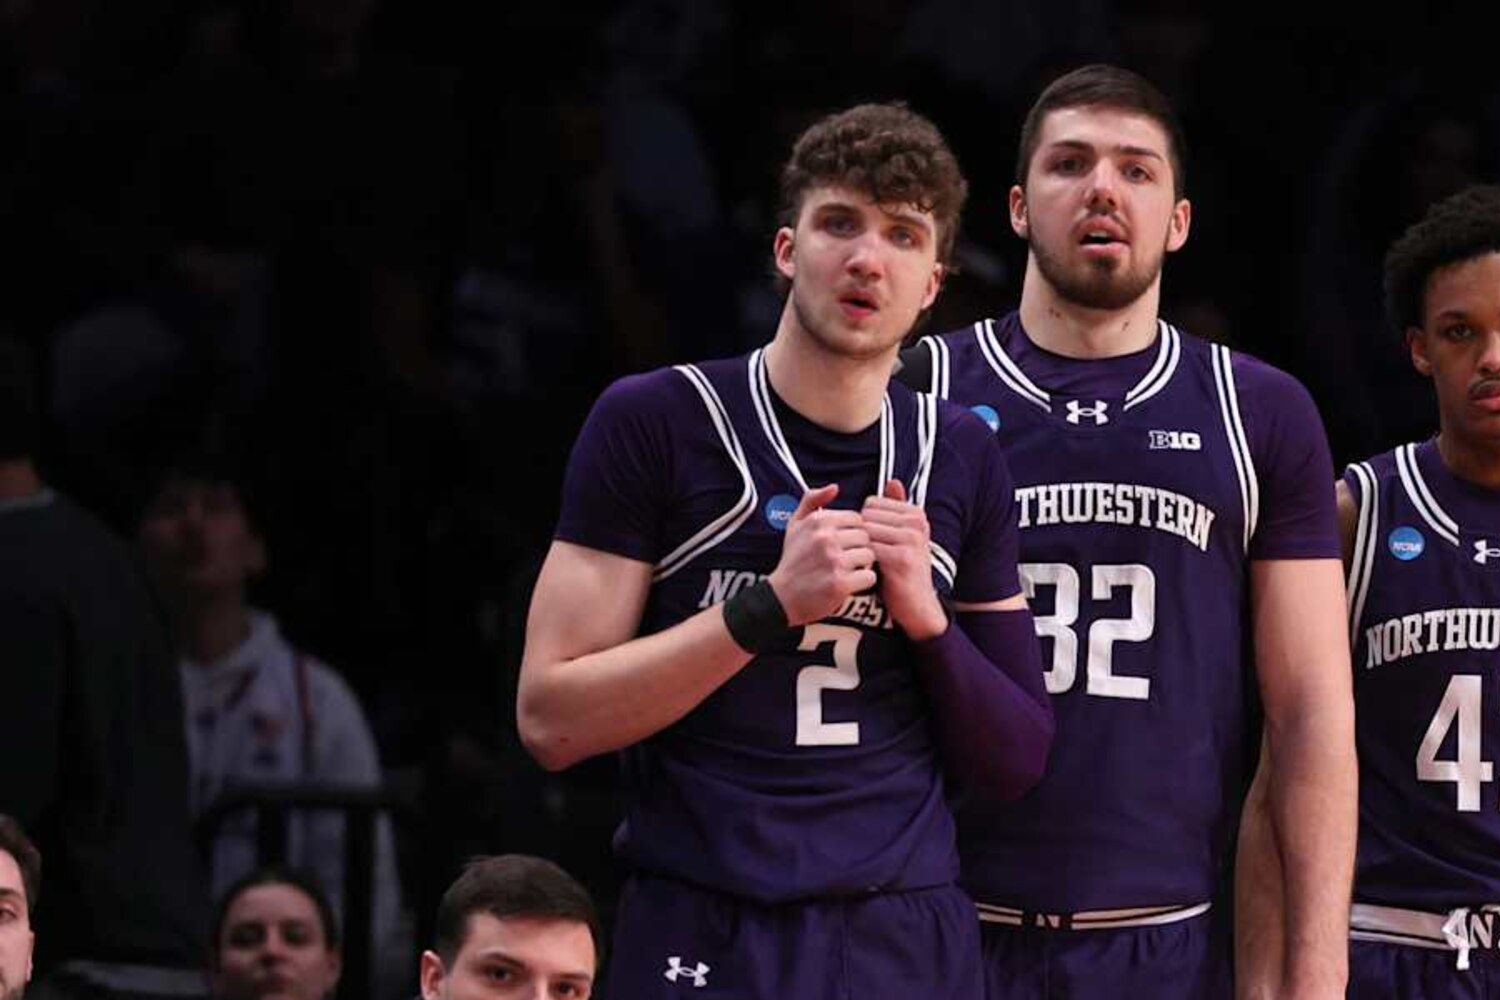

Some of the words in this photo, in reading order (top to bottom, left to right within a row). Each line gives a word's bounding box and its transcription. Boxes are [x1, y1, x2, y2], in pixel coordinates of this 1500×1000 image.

[1014, 482, 1216, 552] THWESTERN
[796, 622, 863, 746] 2
[1017, 563, 1156, 700] 32
